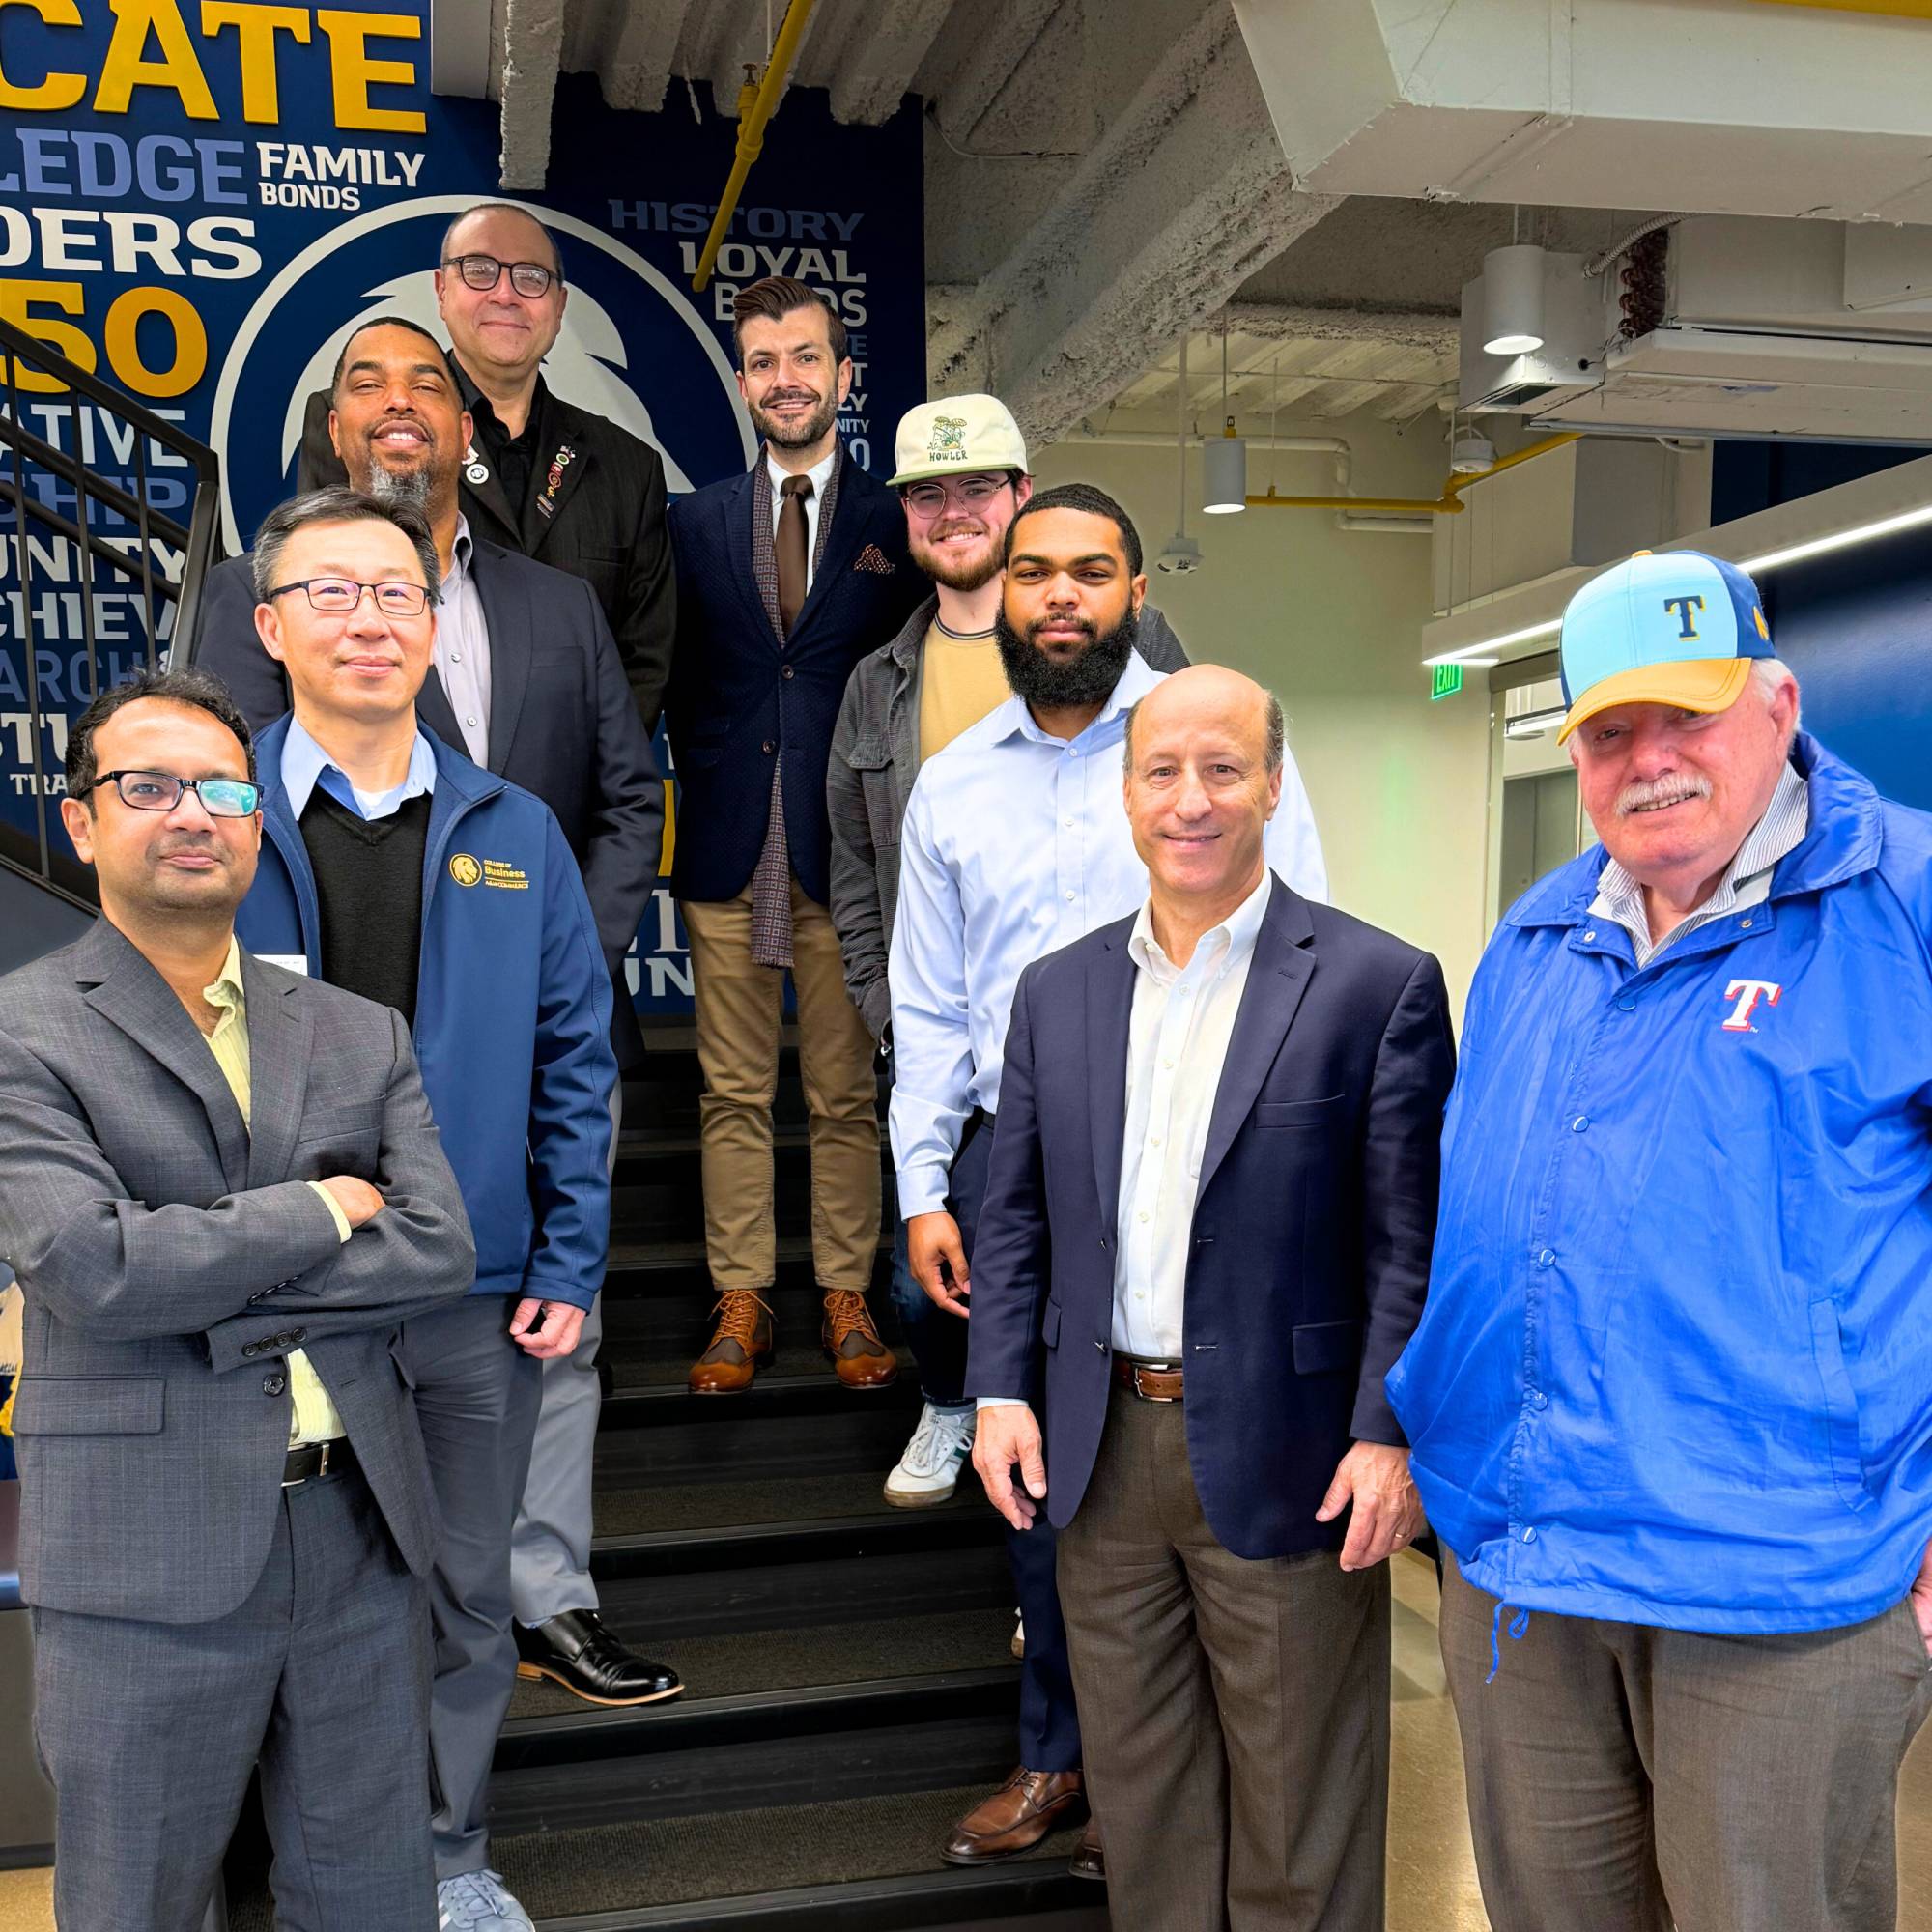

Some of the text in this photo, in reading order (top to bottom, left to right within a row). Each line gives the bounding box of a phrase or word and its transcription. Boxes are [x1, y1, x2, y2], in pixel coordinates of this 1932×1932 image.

[256, 142, 425, 187] FAMILY
[258, 182, 361, 212] BONDS
[679, 242, 867, 283] LOYAL
[929, 451, 968, 462] HOWLER
[0, 591, 177, 640] HIEV
[1663, 595, 1706, 641] T
[1721, 979, 1782, 1032] T
